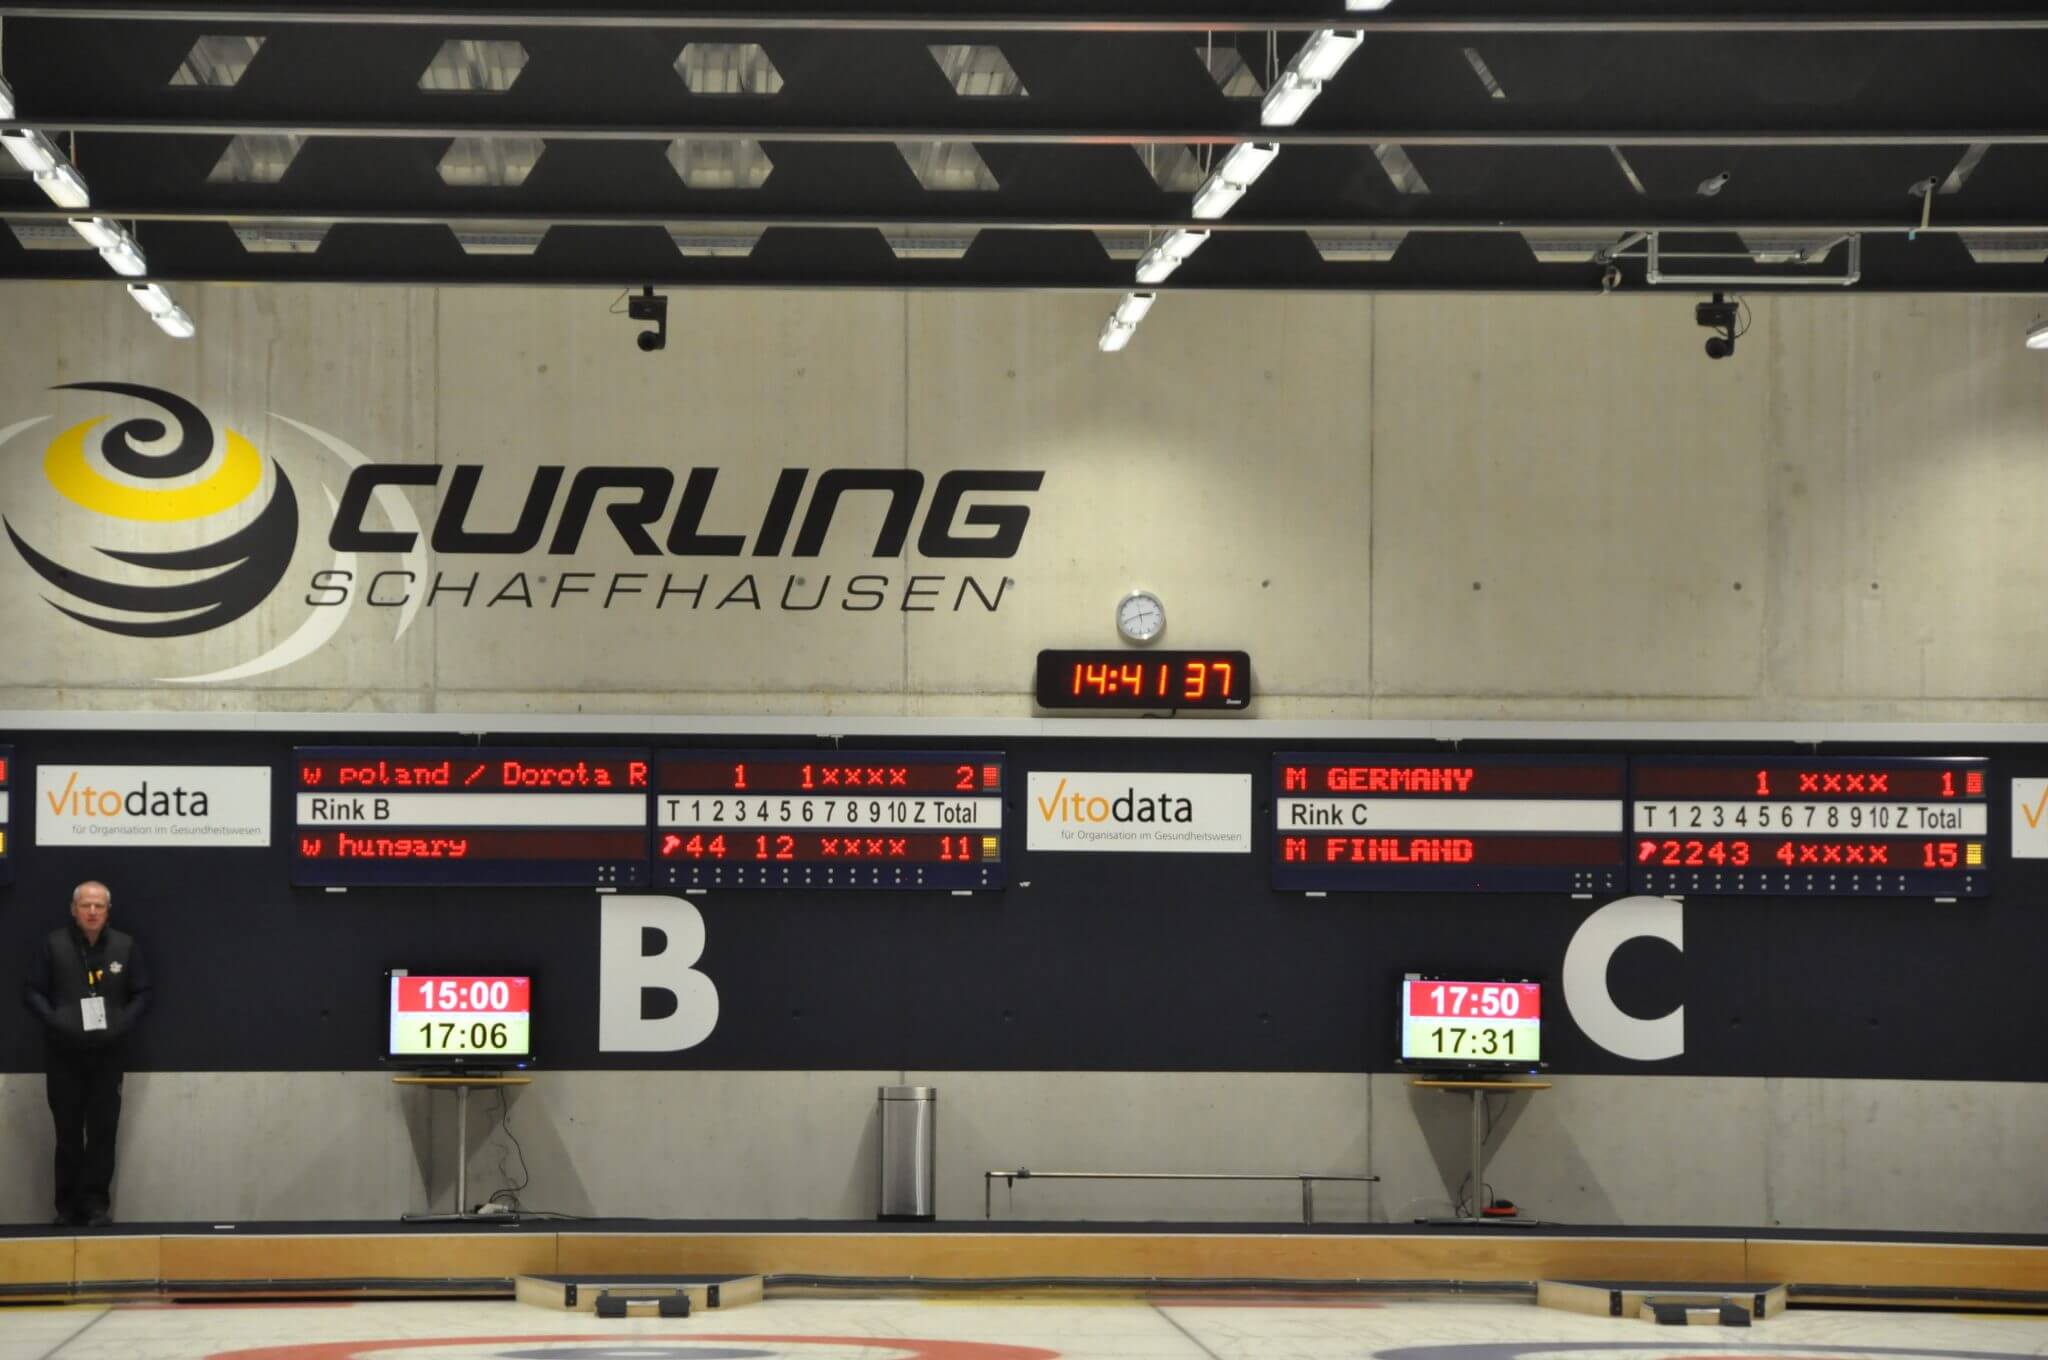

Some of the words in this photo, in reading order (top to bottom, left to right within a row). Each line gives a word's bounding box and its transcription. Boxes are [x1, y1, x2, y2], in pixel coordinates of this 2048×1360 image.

[330, 464, 1044, 558] CURLING
[306, 571, 1007, 612] SCHAFFHAUSEN
[1074, 664, 1167, 695] 14:41
[1185, 662, 1231, 698] 37
[339, 761, 450, 786] poland
[503, 761, 612, 787] Dorota
[628, 761, 648, 786] R
[734, 764, 747, 789] 1
[955, 765, 974, 790] 2
[1285, 767, 1307, 791] M
[1327, 767, 1474, 792] GERMANY
[1756, 770, 1770, 796] 1
[1941, 771, 1955, 797] 1
[312, 798, 365, 820] Rink
[374, 798, 390, 820] B
[666, 799, 681, 822] T
[691, 799, 700, 822] 1
[712, 799, 724, 822] 2
[735, 799, 747, 822] 3
[756, 799, 769, 822] 4
[780, 799, 791, 822] 5
[802, 800, 814, 823] 6
[824, 800, 836, 823] 7
[846, 800, 858, 823] 8
[869, 800, 881, 823] 9
[887, 801, 907, 823] 10
[913, 801, 926, 824] Z
[933, 801, 977, 824] Total
[1291, 803, 1343, 825] Rink
[1351, 803, 1367, 826] C
[1643, 805, 1657, 828] T
[1668, 805, 1677, 828] 1
[1690, 805, 1702, 828] 2
[1713, 805, 1725, 828] 3
[1735, 805, 1748, 828] 4
[1759, 805, 1770, 828] 5
[1781, 805, 1793, 828] 6
[1804, 805, 1816, 828] 7
[1827, 805, 1839, 828] 8
[1850, 805, 1862, 828] 9
[1869, 806, 1889, 829] 10
[1896, 806, 1909, 829] Z
[1916, 806, 1962, 829] Total
[71, 824, 87, 835] für
[88, 824, 152, 837] Organisation
[154, 824, 168, 835] im
[169, 824, 262, 836] Gesundheitswesen
[1060, 829, 1076, 840] für
[1077, 829, 1138, 842] Organisation
[1139, 829, 1152, 841] im
[1154, 830, 1243, 842] Gesundheitswesen
[338, 832, 468, 858] hungary
[940, 836, 970, 861] 11
[1284, 838, 1307, 861] M
[1326, 838, 1473, 863] FINLAND
[1923, 842, 1958, 868] 15
[600, 896, 718, 1051] B
[1564, 895, 1683, 1059] C
[419, 980, 509, 1010] 15:00
[1430, 985, 1520, 1016] 17:50
[420, 1022, 508, 1049] 17:06
[1431, 1027, 1514, 1055] 17:31
